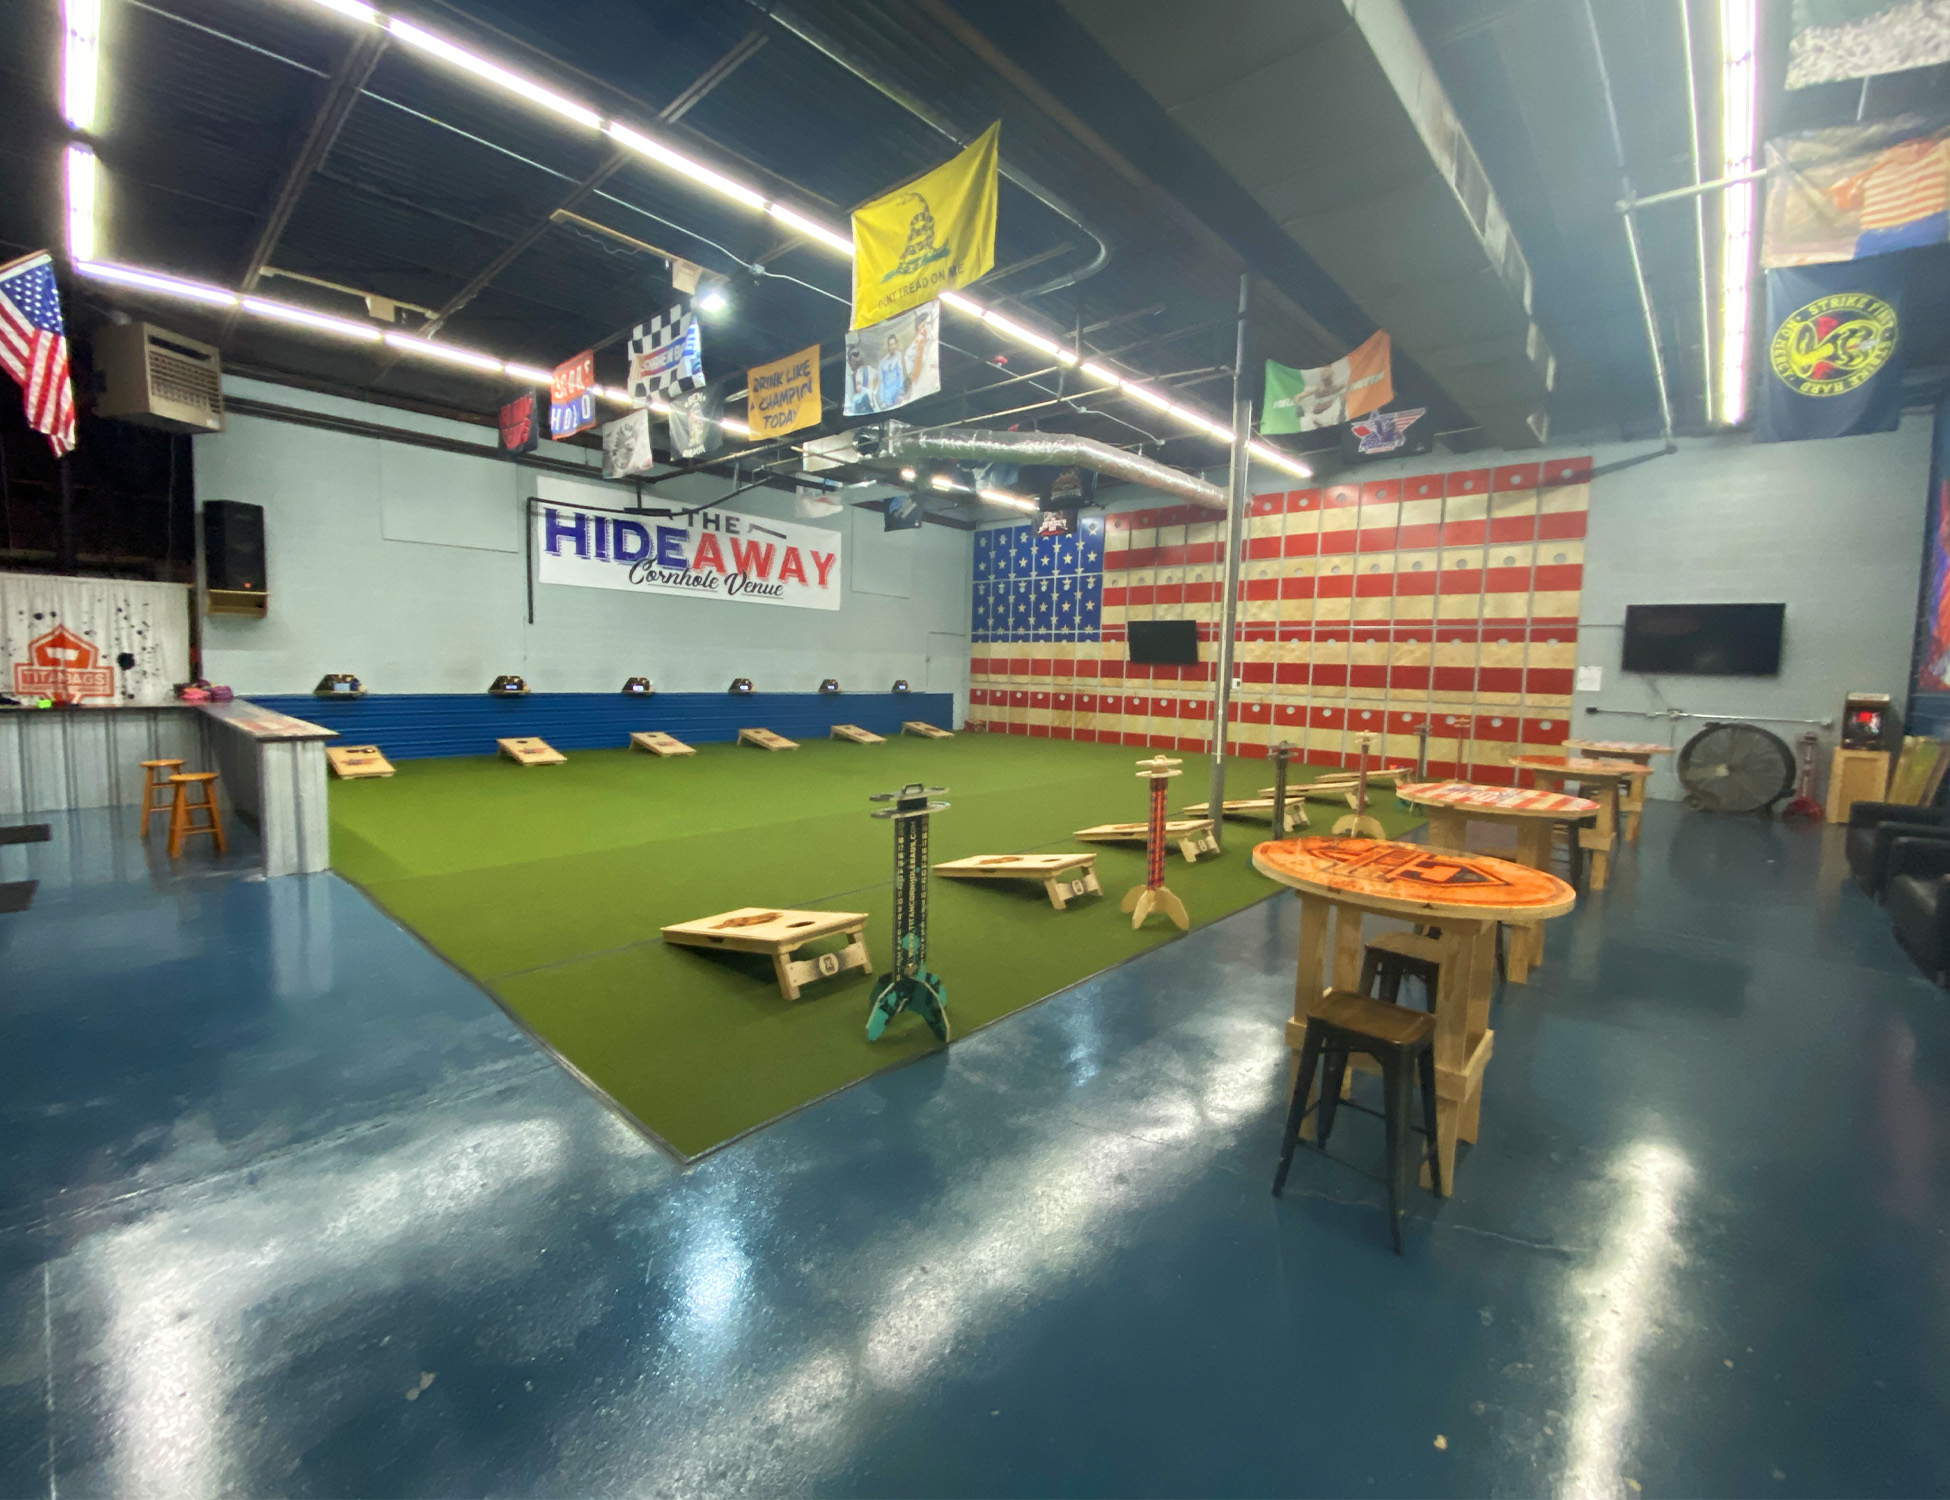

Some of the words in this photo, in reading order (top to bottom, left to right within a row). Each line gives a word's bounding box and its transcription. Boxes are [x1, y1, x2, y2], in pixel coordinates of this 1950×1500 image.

[899, 278, 928, 299] TREAD
[930, 270, 946, 284] ON
[1808, 296, 1869, 316] STRIKE
[753, 371, 783, 393] DRINK
[786, 360, 812, 383] LIKE
[1847, 341, 1892, 386] STRIKE
[1800, 380, 1844, 394] HARD
[682, 508, 740, 535] THE
[629, 555, 720, 590] Cornhole
[724, 570, 784, 597] Venue
